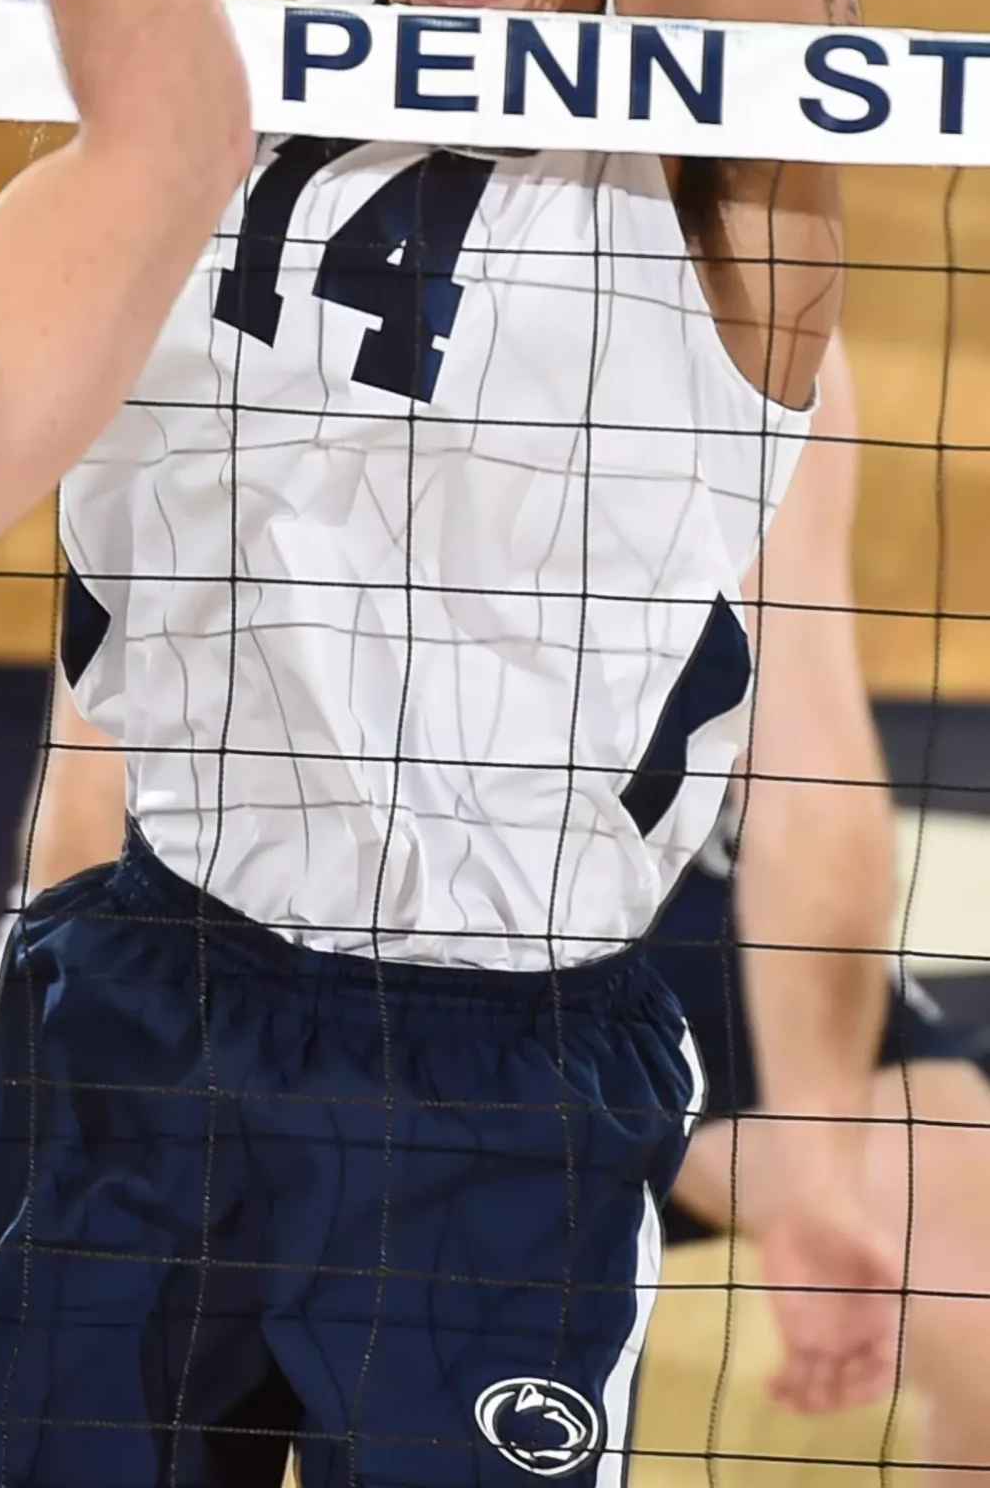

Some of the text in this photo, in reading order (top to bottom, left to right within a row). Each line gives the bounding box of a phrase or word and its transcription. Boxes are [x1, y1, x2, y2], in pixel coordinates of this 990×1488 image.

[281, 7, 990, 135] PENN ST
[212, 134, 496, 404] 14
